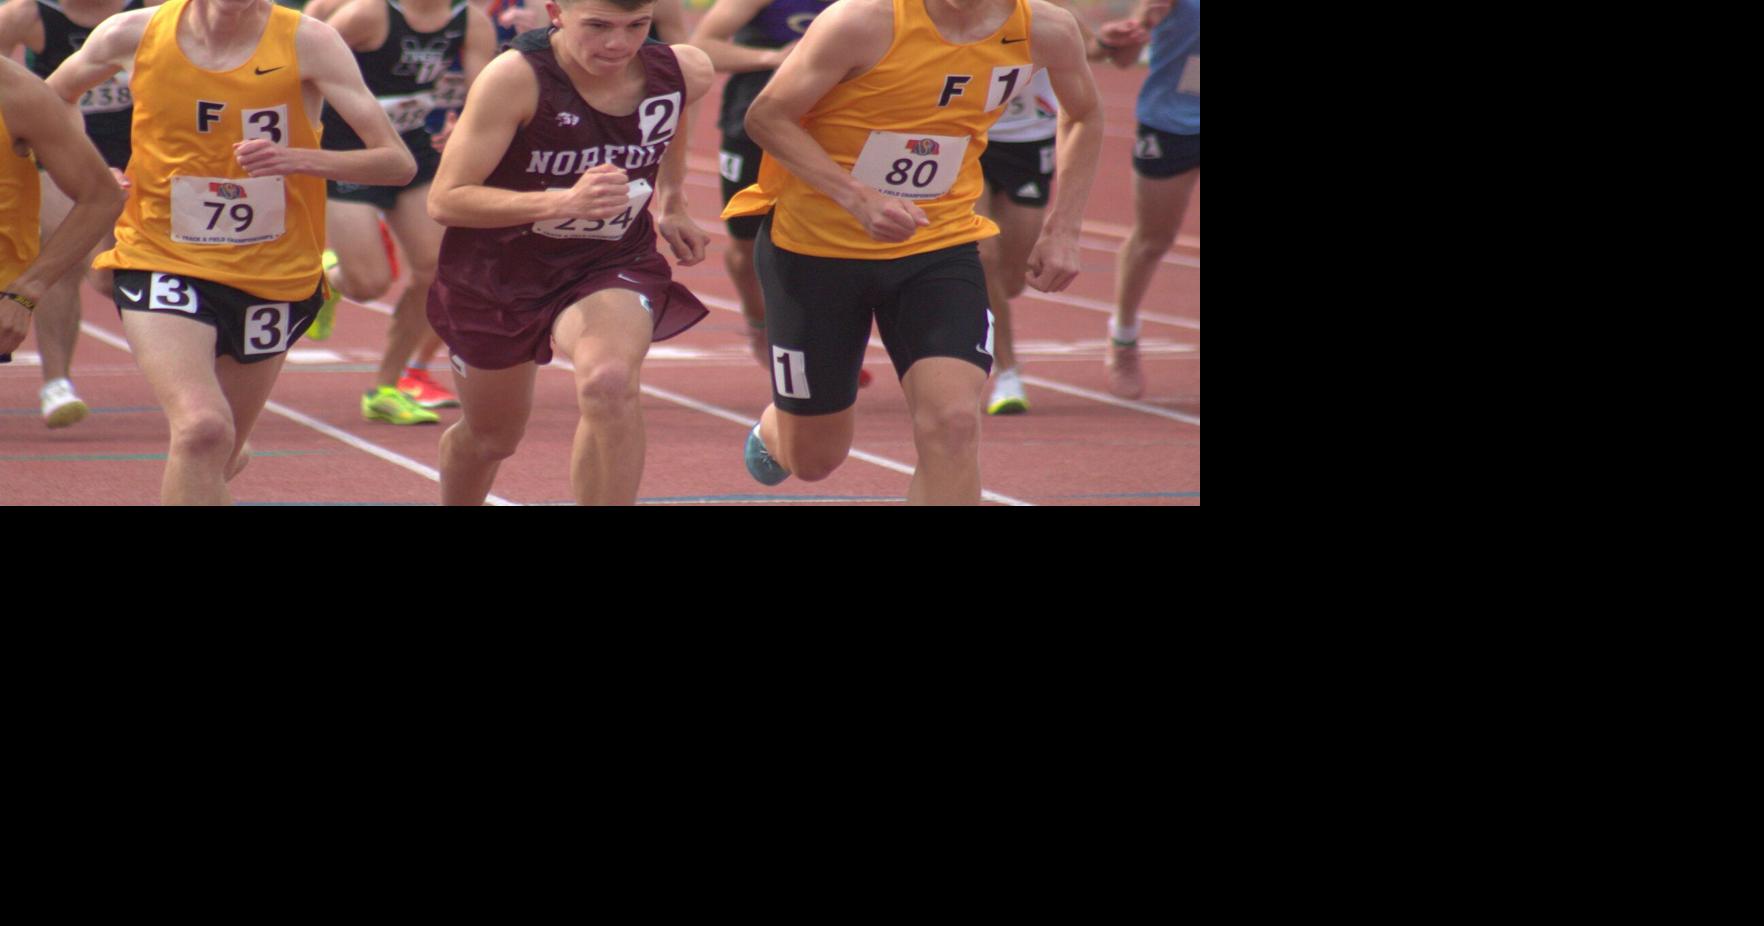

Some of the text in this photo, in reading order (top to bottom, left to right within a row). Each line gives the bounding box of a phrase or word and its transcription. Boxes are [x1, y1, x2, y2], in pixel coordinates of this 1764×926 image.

[938, 74, 971, 107] F
[998, 68, 1019, 106] 1
[197, 100, 226, 133] F
[248, 110, 281, 144] 3
[645, 99, 674, 143] 2
[885, 158, 938, 188] 80
[204, 201, 253, 232] 79
[156, 274, 190, 306] 3
[250, 307, 281, 350] 3
[776, 352, 794, 394] 1
